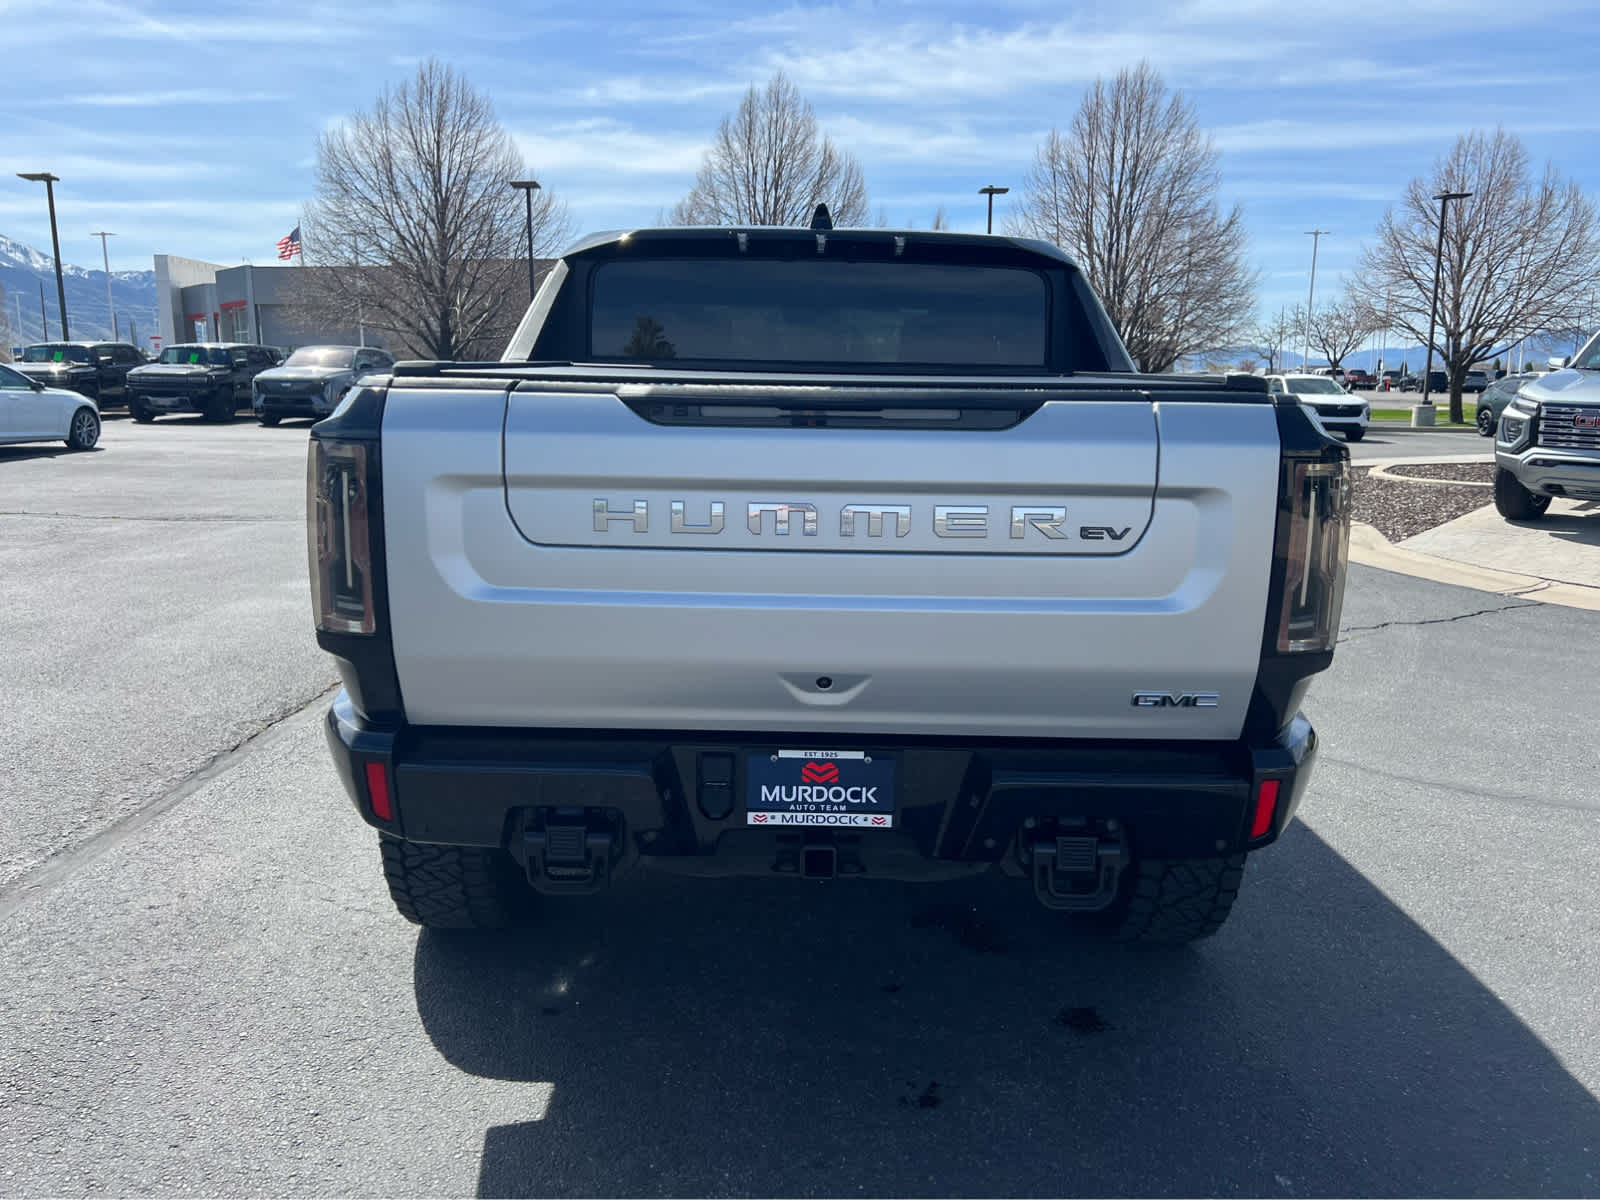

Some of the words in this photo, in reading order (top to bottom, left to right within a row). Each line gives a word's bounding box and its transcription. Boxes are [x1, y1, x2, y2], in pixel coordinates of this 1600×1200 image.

[592, 498, 1068, 540] HUMMER
[1080, 526, 1131, 540] EV
[1131, 692, 1219, 708] GMC
[761, 785, 878, 803] MURDOCK
[820, 804, 847, 812] TEAM
[781, 814, 860, 825] MURDOCK
